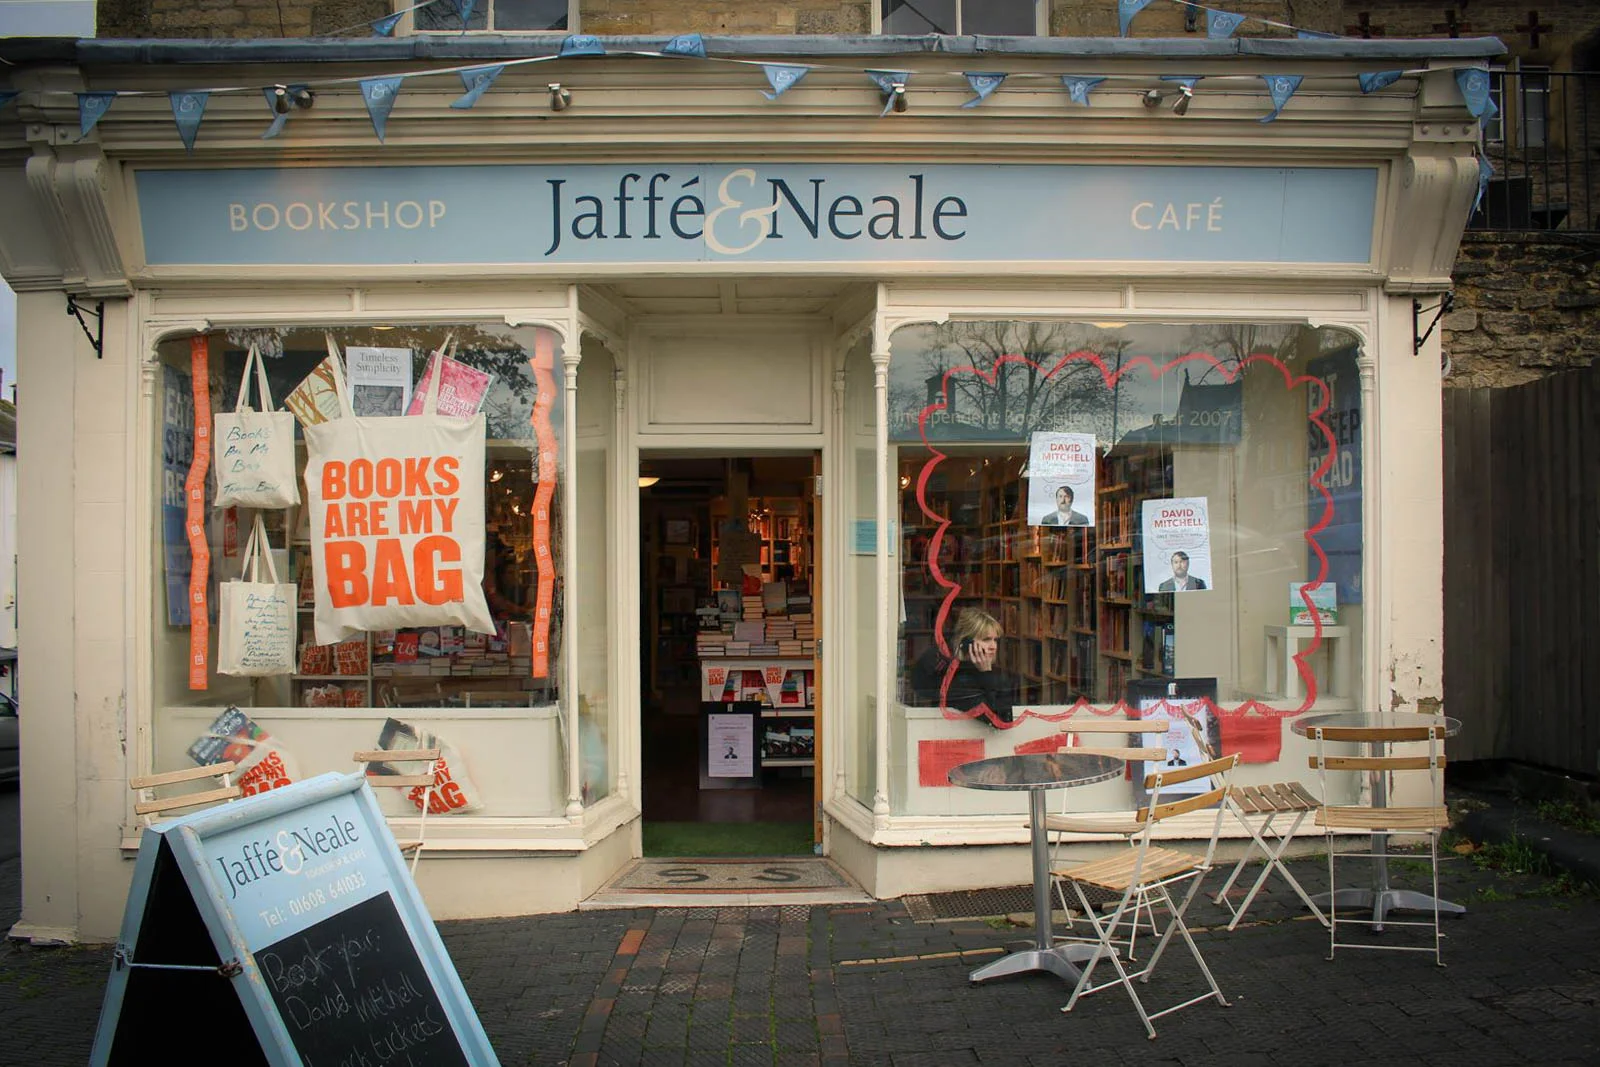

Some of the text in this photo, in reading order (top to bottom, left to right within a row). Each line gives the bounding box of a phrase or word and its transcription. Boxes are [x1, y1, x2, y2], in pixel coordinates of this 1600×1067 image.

[228, 200, 447, 232] BOOKSHOP
[1130, 196, 1224, 231] CAFÉ
[355, 362, 402, 374] Simplicity
[359, 352, 400, 363] Timeless
[1189, 410, 1233, 426] 2007
[1042, 452, 1090, 463] MITCHELL
[1050, 443, 1082, 452] DAVID
[321, 456, 460, 500] BOOKS
[324, 498, 460, 538] ARE MY
[1154, 518, 1203, 528] MITCHELL
[1161, 508, 1194, 518] DAVID
[324, 535, 464, 608] BAG
[259, 908, 288, 929] Tel:
[289, 889, 327, 917] 01608
[262, 937, 332, 993] Book
